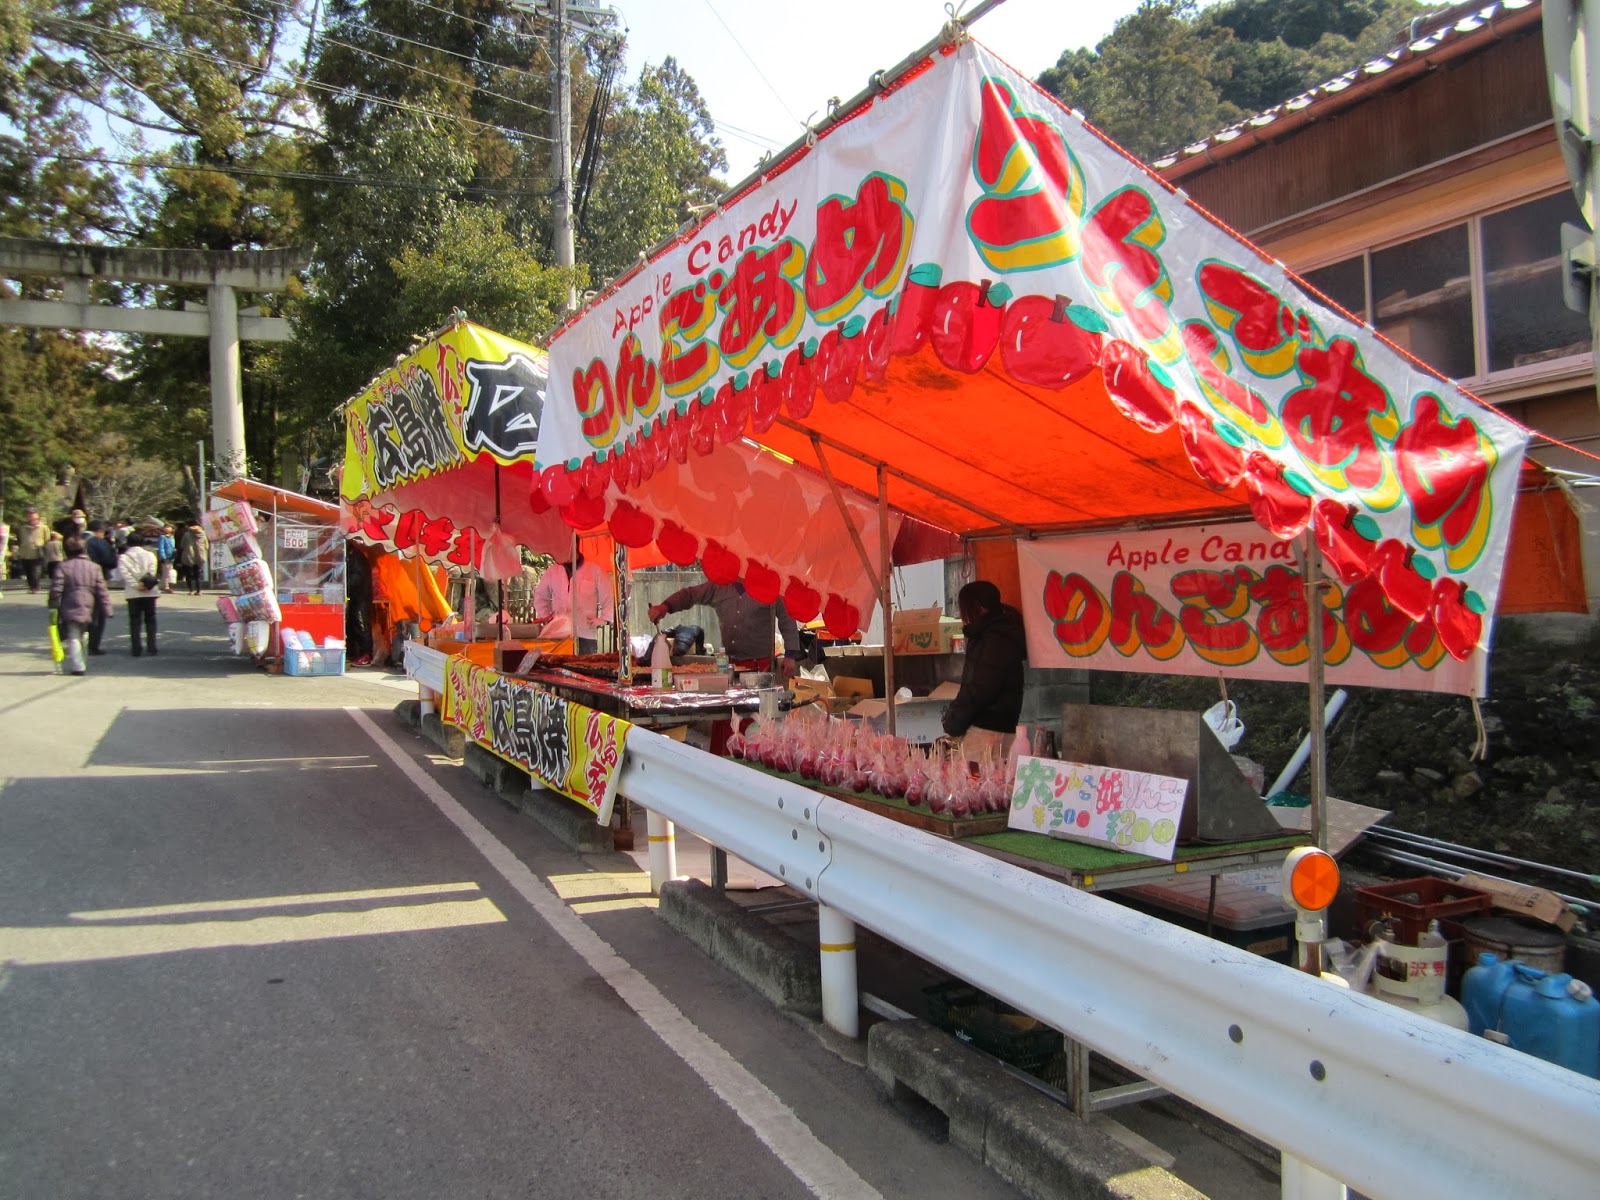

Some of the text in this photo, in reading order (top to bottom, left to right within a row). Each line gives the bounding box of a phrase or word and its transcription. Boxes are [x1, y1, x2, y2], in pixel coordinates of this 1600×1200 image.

[573, 170, 914, 447] りんごあめ
[612, 198, 798, 339] Apple Candy
[966, 75, 1498, 573] りんごあめ
[1043, 565, 1448, 671] りんごあめ
[1107, 535, 1301, 572] Apple Cand
